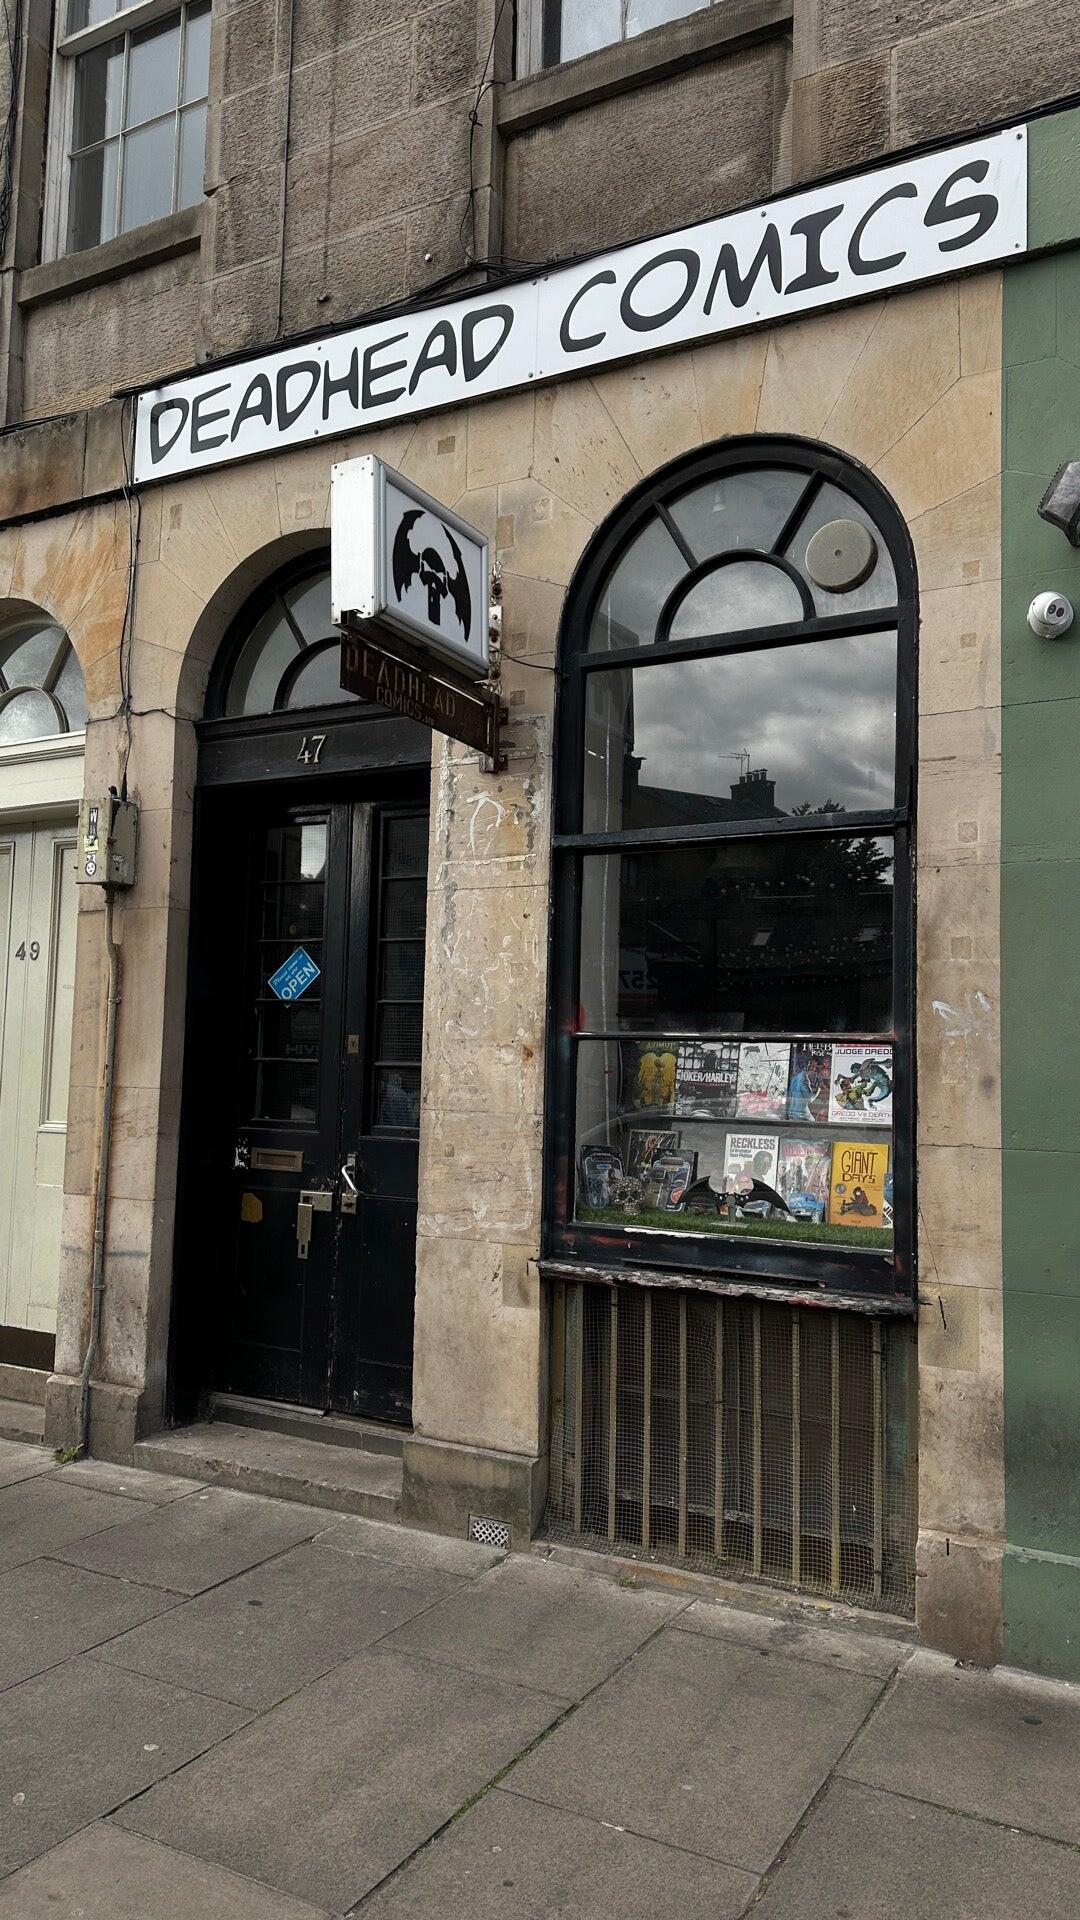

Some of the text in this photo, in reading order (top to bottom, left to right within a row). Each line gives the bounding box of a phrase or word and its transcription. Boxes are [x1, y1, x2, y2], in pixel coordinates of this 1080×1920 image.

[151, 159, 999, 465] DEADHEAD COMICS
[376, 686, 422, 720] COMICS
[296, 734, 326, 764] 47
[15, 941, 41, 961] 49
[281, 962, 316, 1000] OPEN
[680, 1069, 733, 1084] JOKER/HARLEY
[730, 1136, 776, 1151] RECKLESS
[841, 1150, 879, 1174] GIANT
[842, 1173, 876, 1184] DAYS
